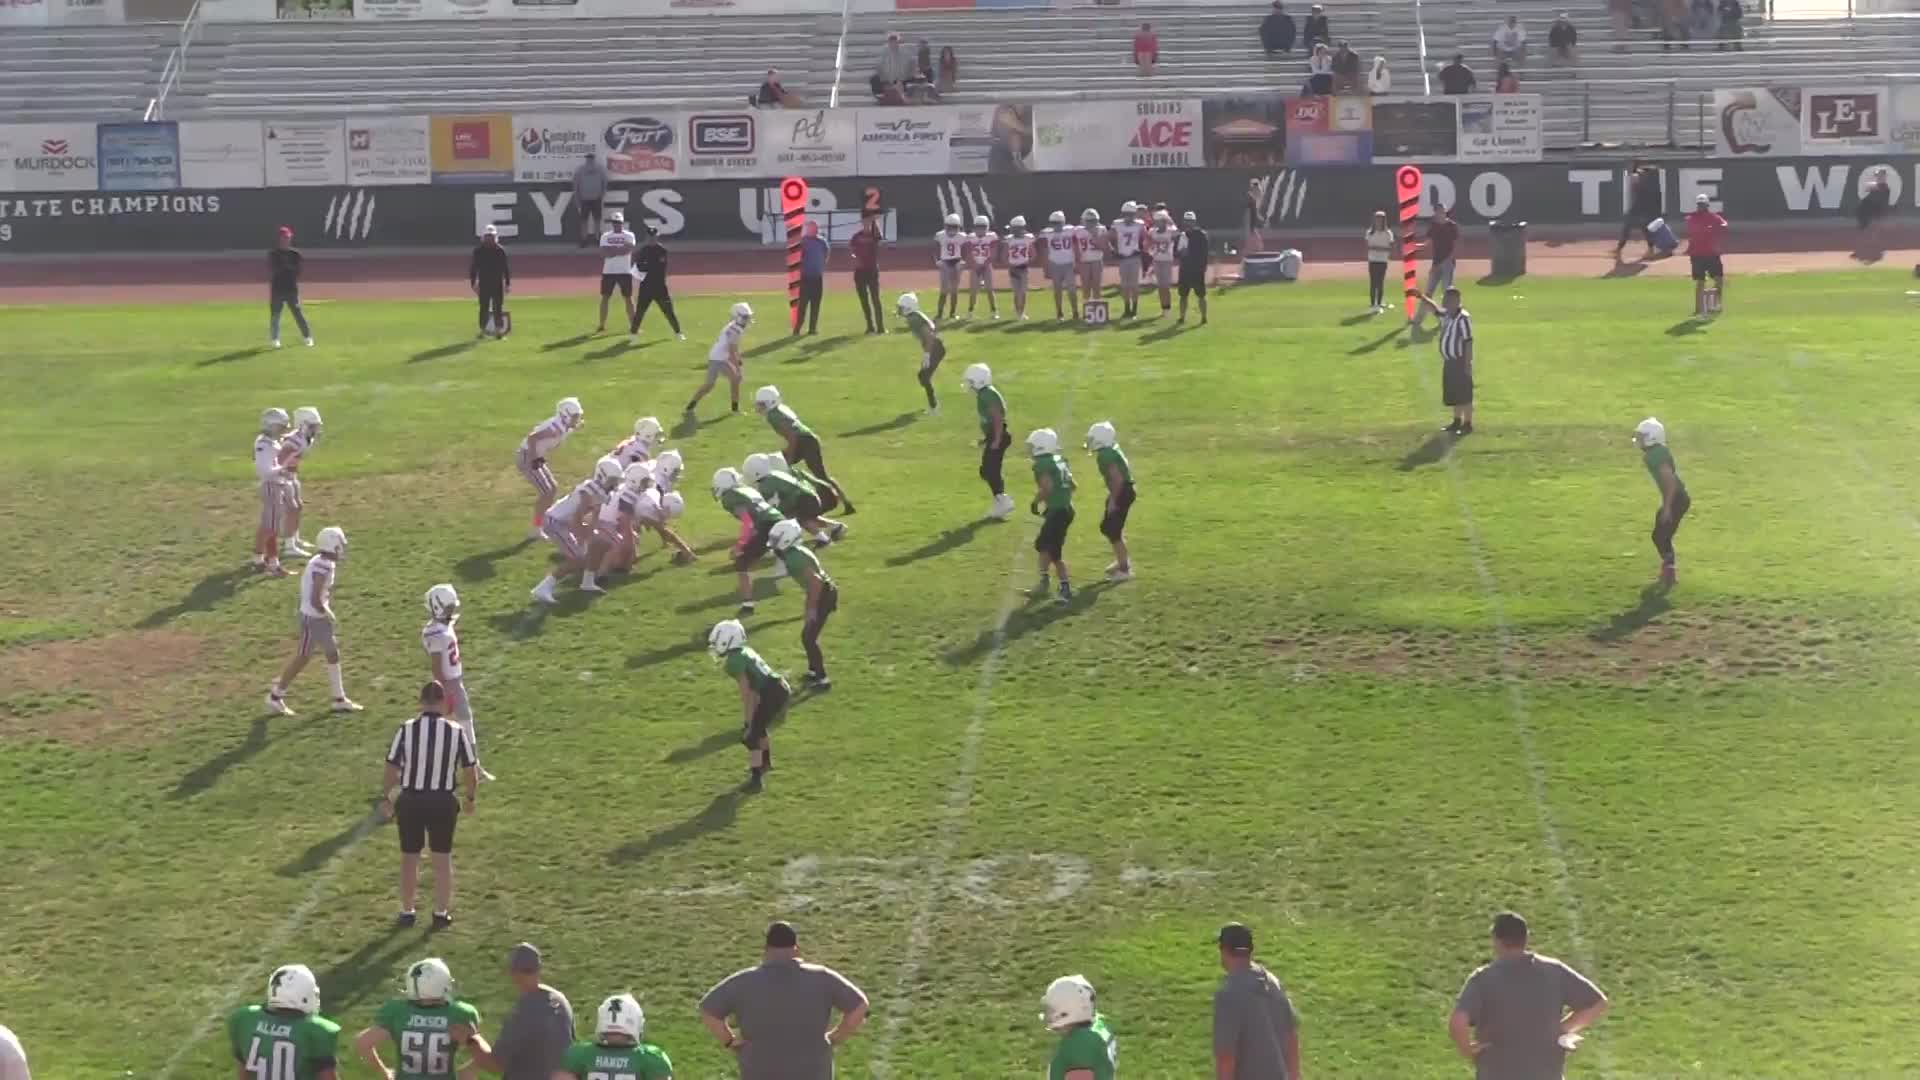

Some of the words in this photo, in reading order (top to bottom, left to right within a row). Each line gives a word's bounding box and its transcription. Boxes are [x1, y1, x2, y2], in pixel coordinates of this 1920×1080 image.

[1816, 99, 1873, 134] LEI
[704, 127, 741, 142] BSE
[857, 133, 911, 142] AMERICA
[912, 132, 944, 141] FIRST
[1128, 118, 1192, 148] ACE
[15, 157, 96, 170] MURDOCK
[1131, 152, 1190, 167] HARDWARE
[865, 187, 880, 208] 2
[1417, 171, 1513, 218] DO
[1775, 163, 1920, 211] WO
[71, 196, 221, 215] CHAMPIONS
[1084, 306, 1107, 323] 50
[255, 1020, 294, 1038] ALLEN
[245, 1036, 296, 1080] 40
[400, 1030, 450, 1074] 56
